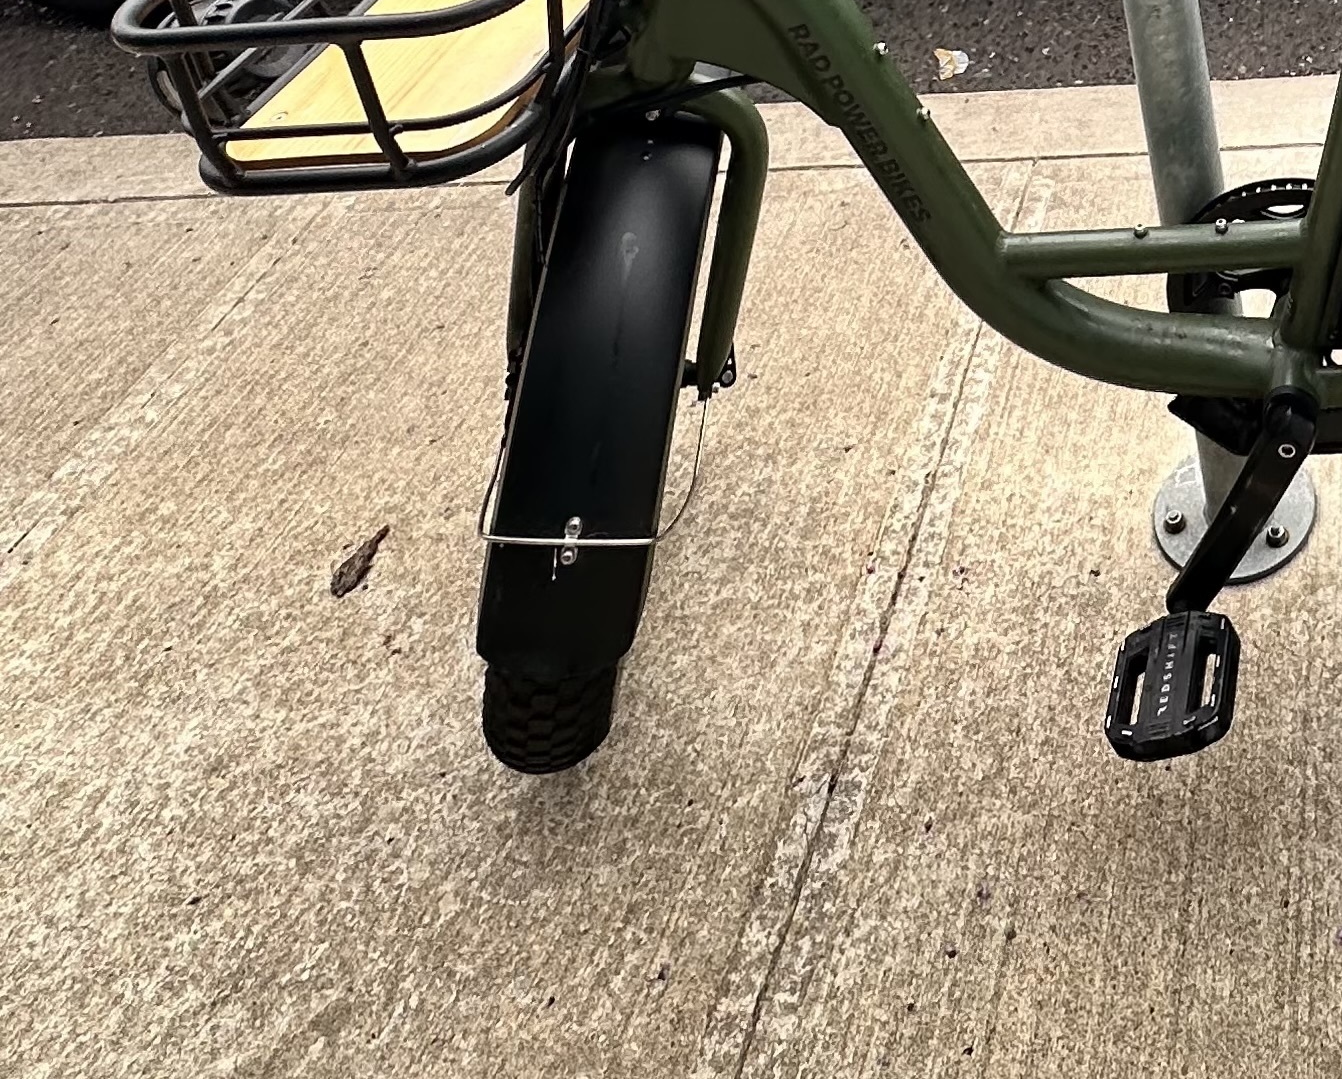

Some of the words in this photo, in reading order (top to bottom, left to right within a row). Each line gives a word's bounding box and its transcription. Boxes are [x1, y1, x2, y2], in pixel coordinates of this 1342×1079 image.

[787, 23, 832, 73] RAD
[822, 73, 889, 160] POWER
[875, 158, 932, 222] BIKES
[1156, 632, 1179, 717] REDSHIFT
